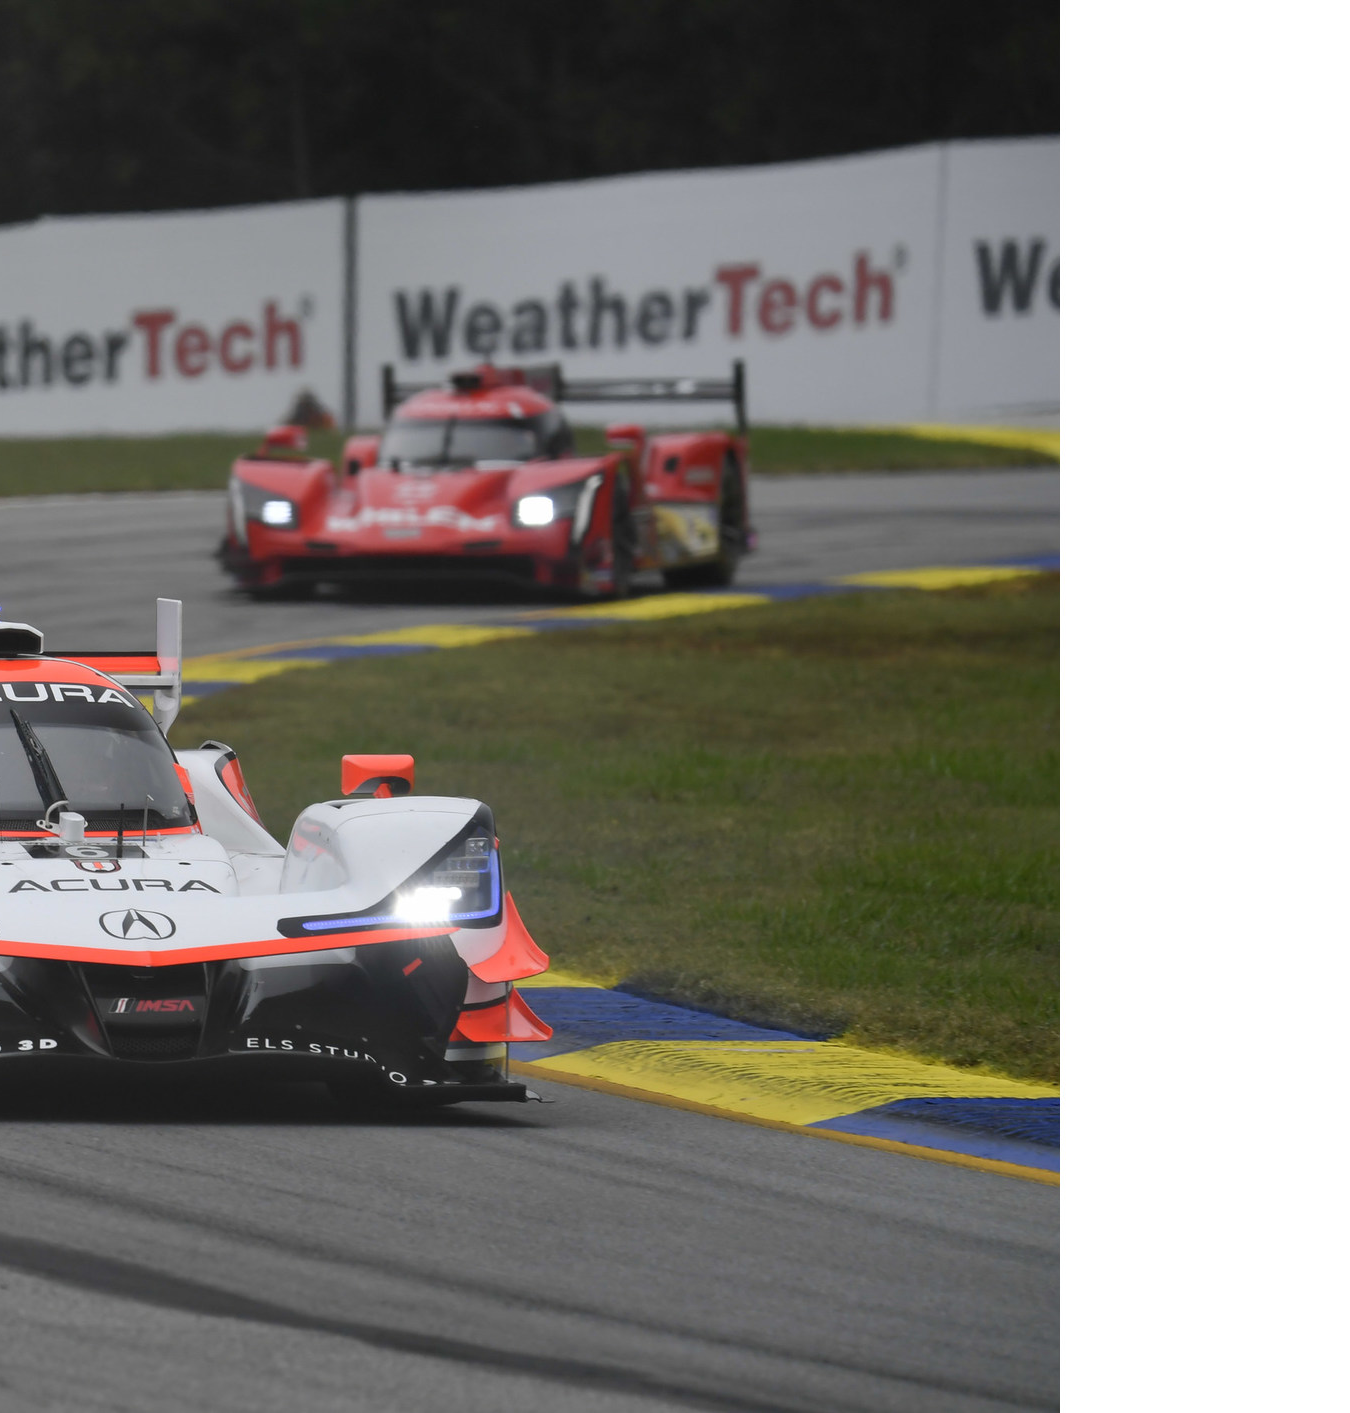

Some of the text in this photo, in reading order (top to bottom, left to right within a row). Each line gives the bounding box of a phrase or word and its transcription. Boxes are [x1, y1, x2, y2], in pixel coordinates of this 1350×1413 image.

[972, 238, 1060, 318] W
[395, 250, 896, 361] WeatherTech
[65, 845, 109, 858] 6
[8, 879, 221, 894] ACURA
[136, 999, 195, 1012] IMSA
[18, 1039, 58, 1051] 3D
[246, 1037, 295, 1051] ELS
